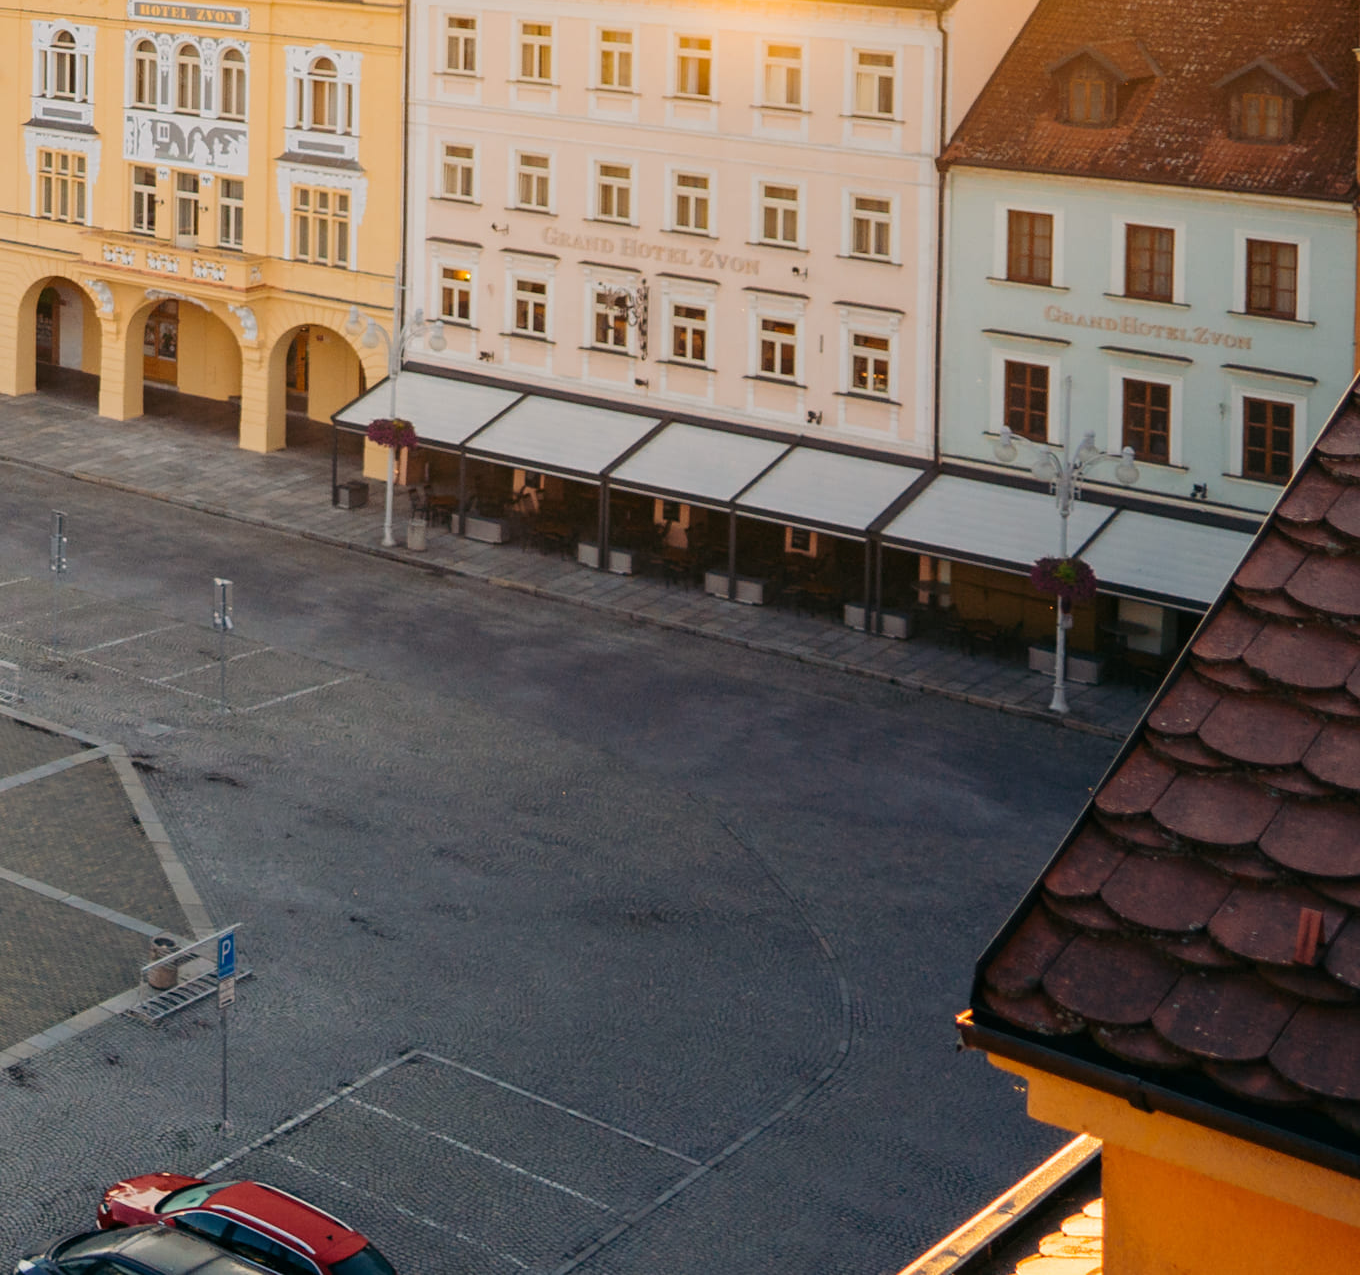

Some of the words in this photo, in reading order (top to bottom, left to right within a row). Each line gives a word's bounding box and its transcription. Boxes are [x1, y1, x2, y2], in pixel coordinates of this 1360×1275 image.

[140, 4, 191, 20] HOTEL
[196, 9, 236, 23] ZVON
[222, 939, 231, 965] P
